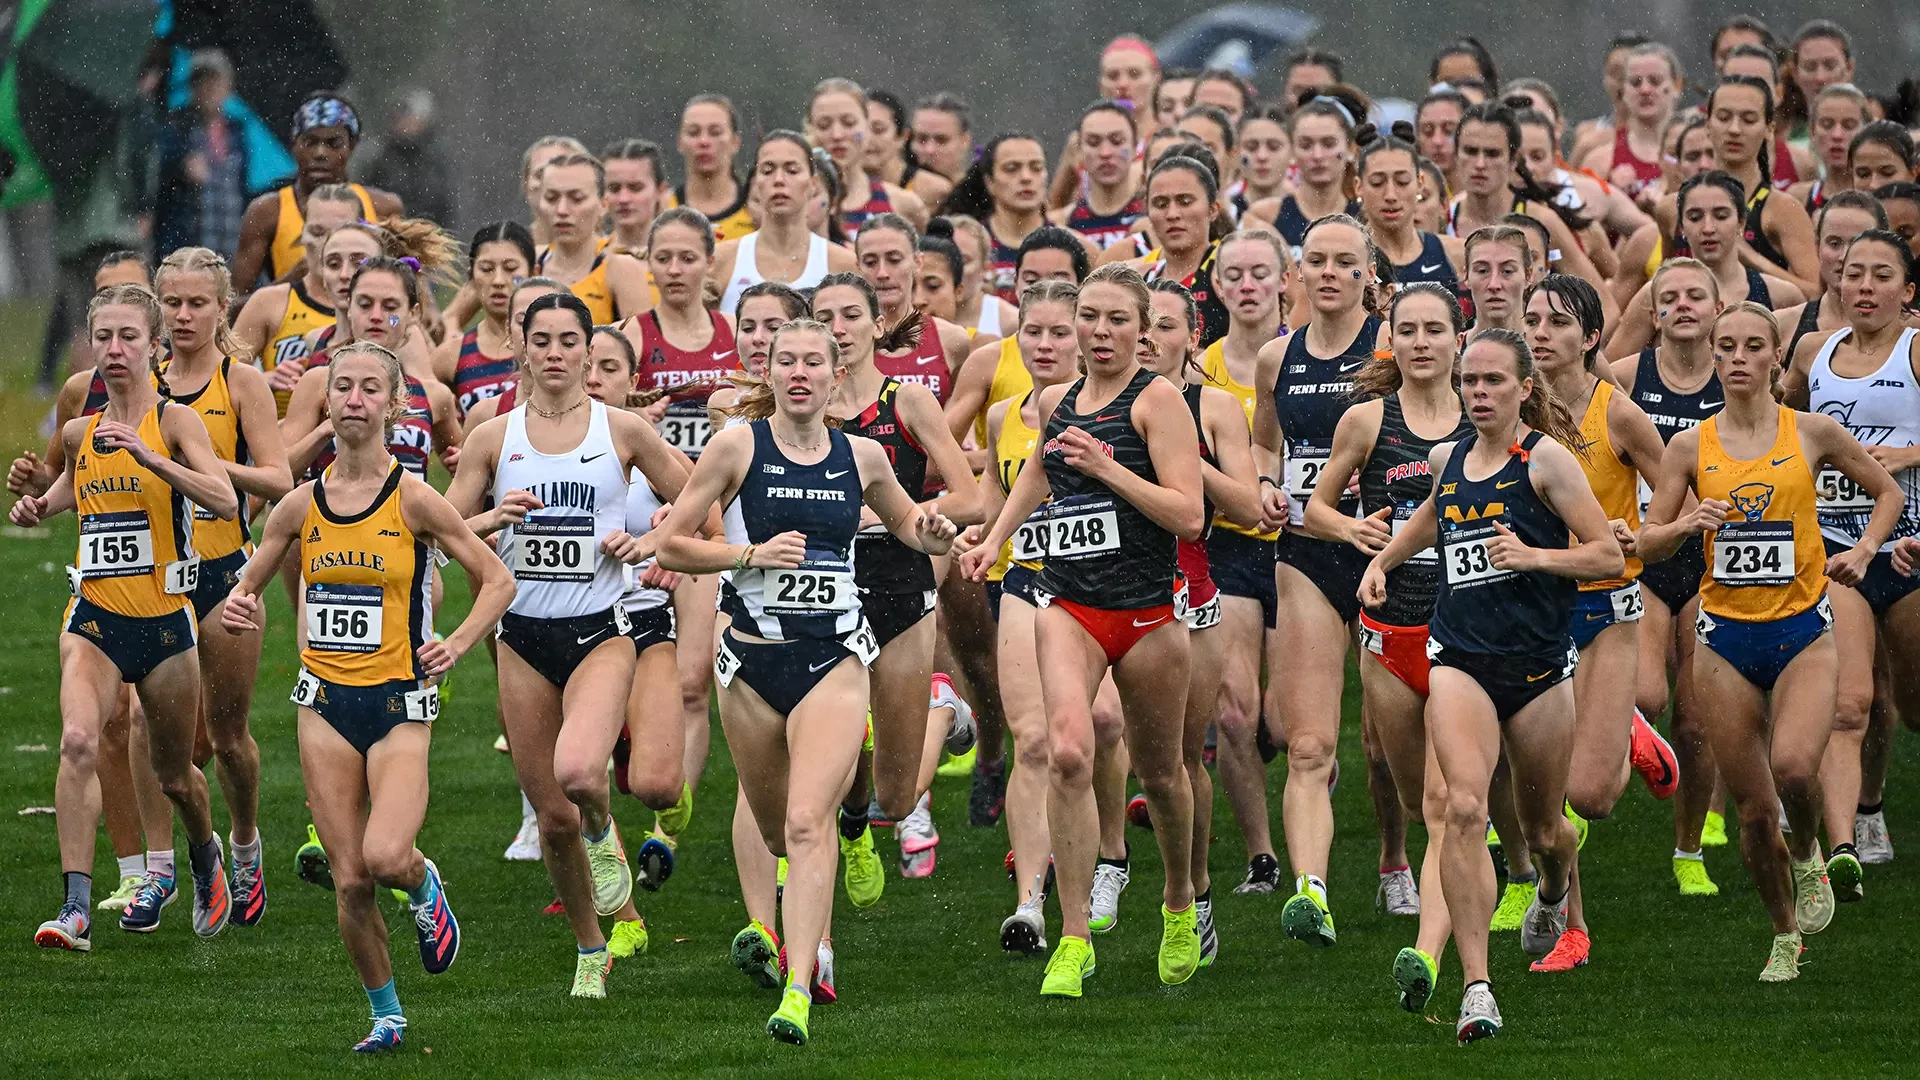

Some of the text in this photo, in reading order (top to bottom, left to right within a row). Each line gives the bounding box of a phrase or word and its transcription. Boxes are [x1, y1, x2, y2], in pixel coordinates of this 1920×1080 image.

[1288, 382, 1354, 395] PENN STATE
[1386, 460, 1433, 485] PRIN
[522, 482, 595, 514] LANOVA
[767, 487, 846, 501] PENN STATE
[1019, 524, 1050, 554] 20
[1057, 517, 1106, 550] 248
[89, 536, 140, 564] 155
[525, 539, 581, 568] 330
[1455, 544, 1488, 577] 33
[1725, 546, 1781, 573] 234
[176, 564, 198, 588] 15
[777, 574, 836, 604] 225
[1622, 590, 1643, 616] 23
[317, 608, 369, 639] 156
[418, 693, 438, 718] 15
